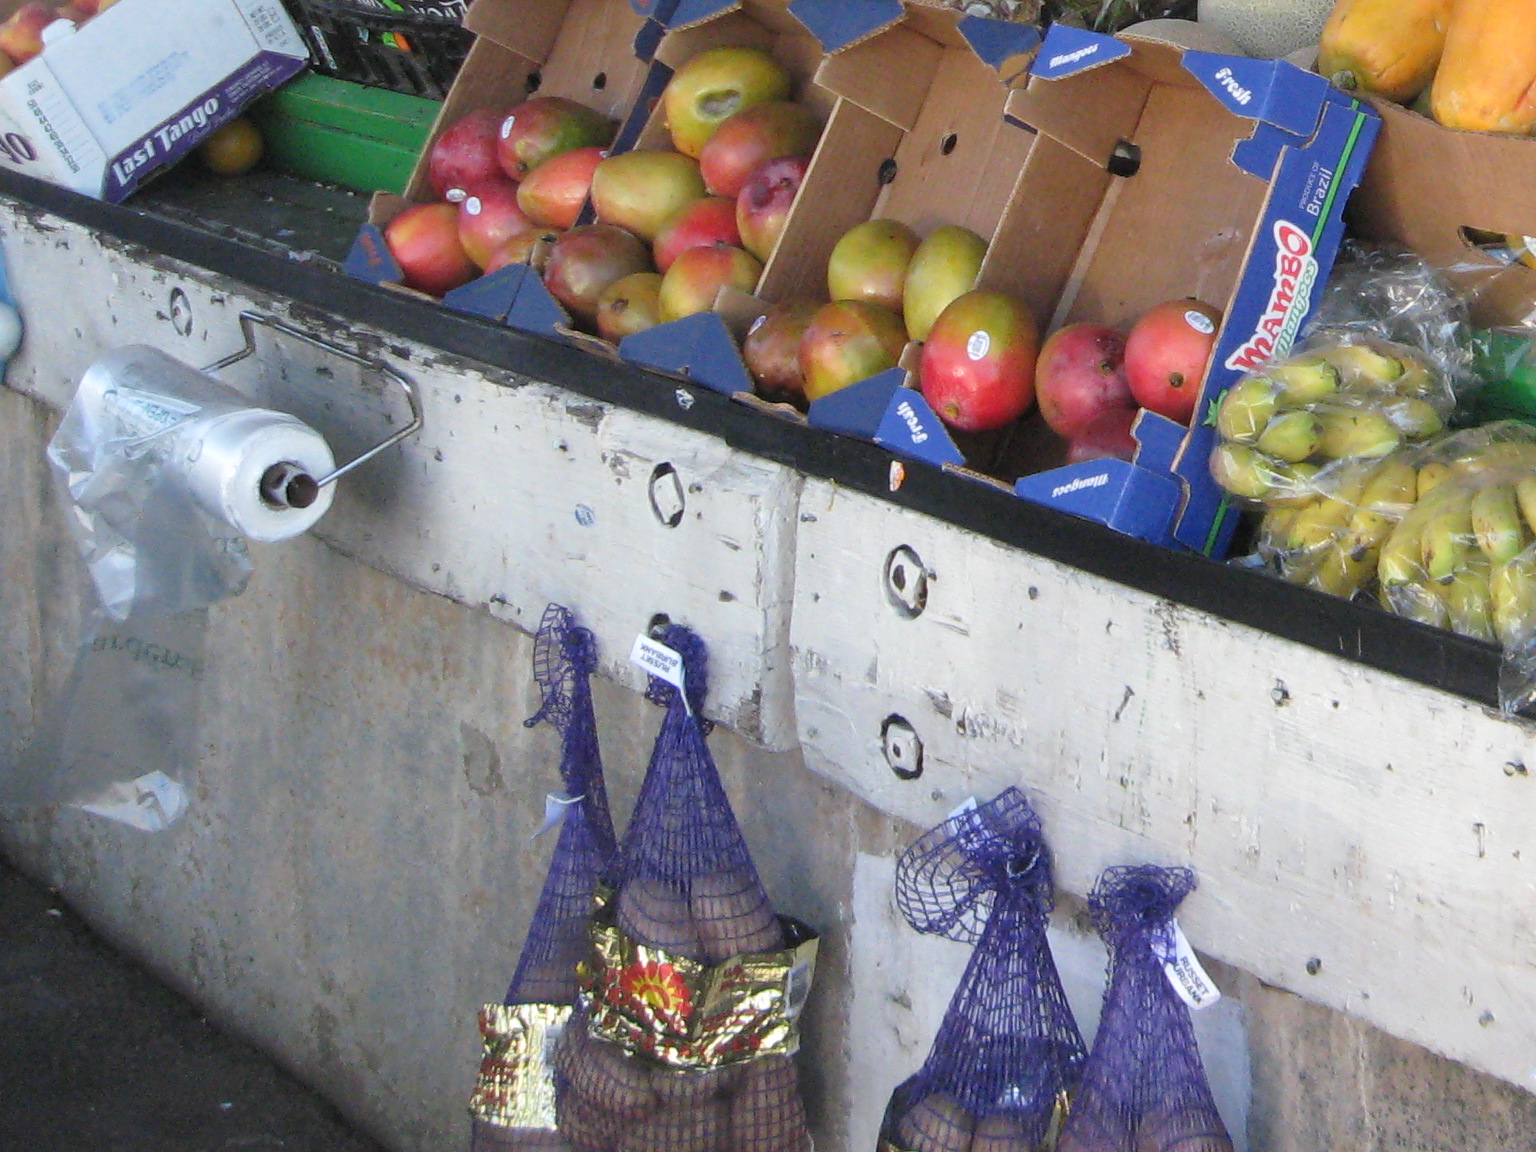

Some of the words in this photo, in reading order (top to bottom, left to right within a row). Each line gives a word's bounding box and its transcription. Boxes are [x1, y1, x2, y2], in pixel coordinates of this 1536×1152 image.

[1049, 43, 1100, 69] Mangoes
[1214, 67, 1254, 106] Fresh
[112, 137, 157, 188] Last
[154, 96, 220, 154] Tango
[1299, 173, 1314, 209] PRODUCT
[1306, 167, 1333, 217] Brazil
[897, 401, 929, 445] Fresh
[1051, 473, 1110, 498] Mangoes
[640, 653, 671, 673] RUSSET
[641, 641, 679, 666] BURBANK
[1180, 955, 1210, 995] RUSSET
